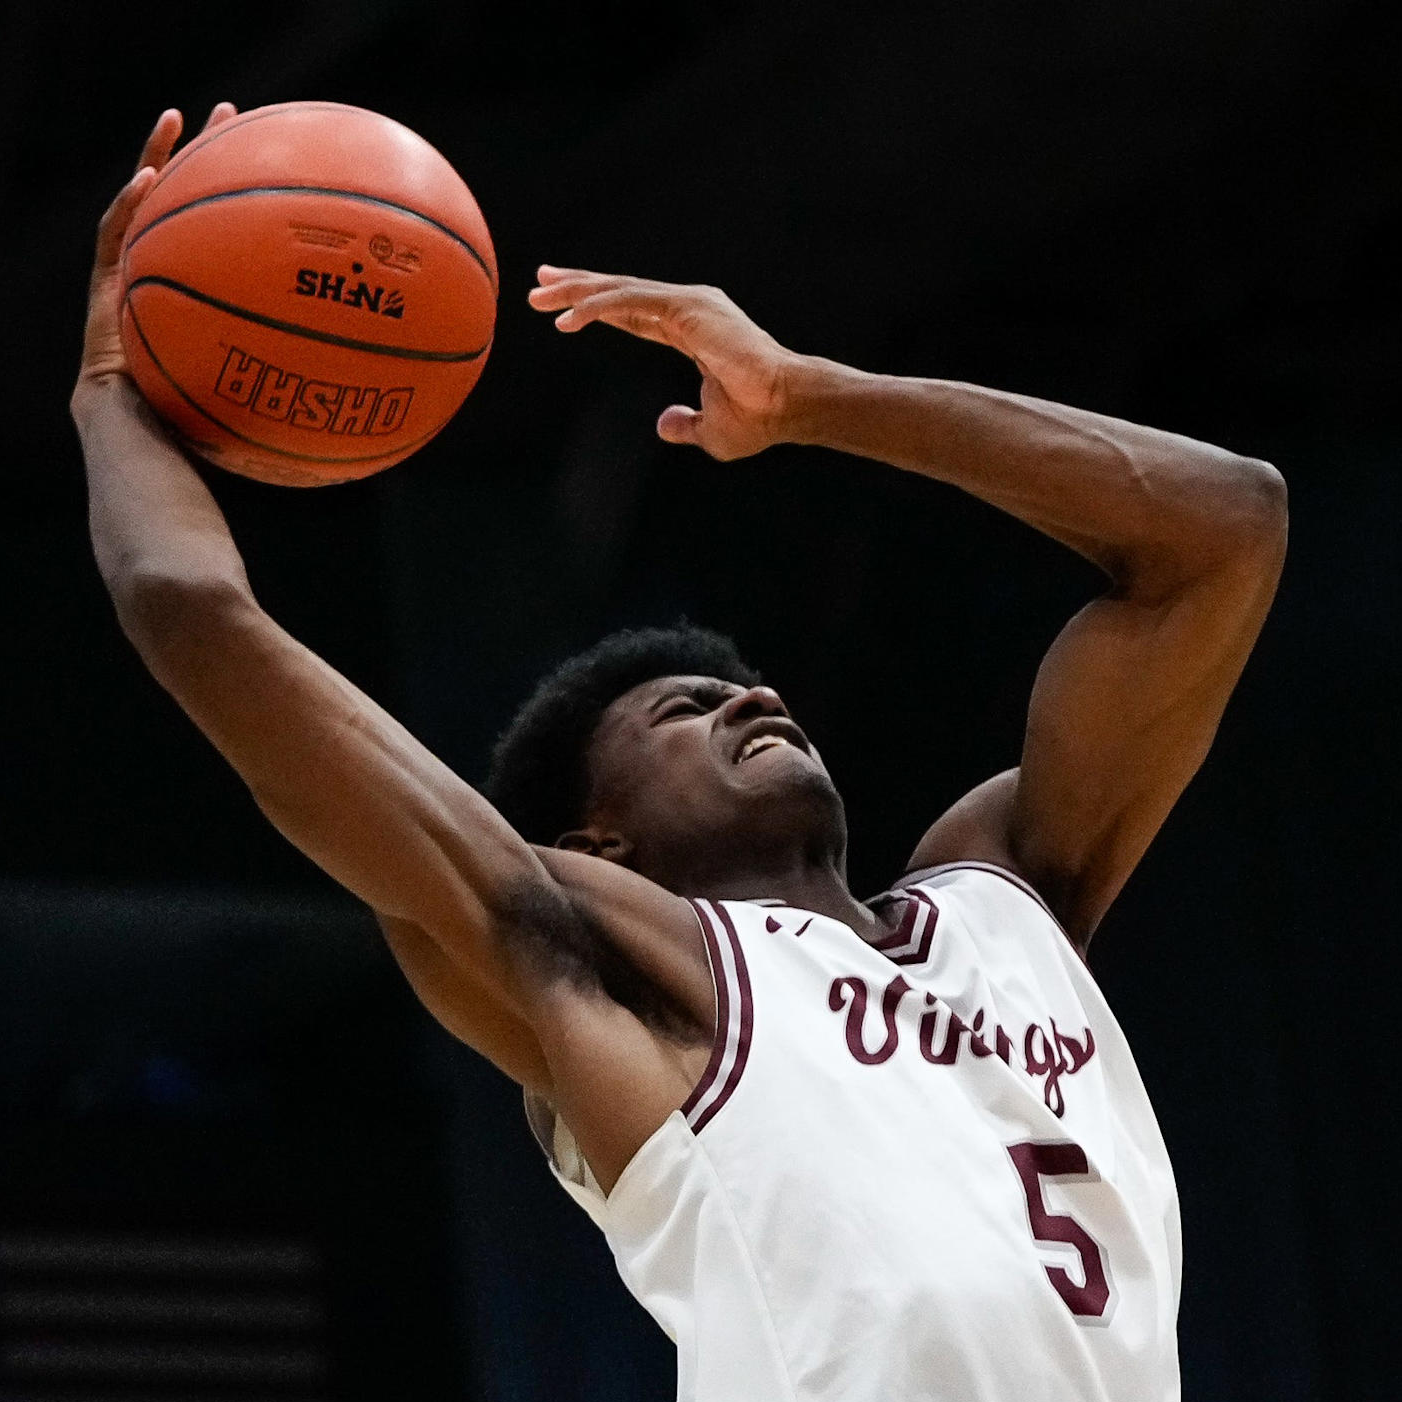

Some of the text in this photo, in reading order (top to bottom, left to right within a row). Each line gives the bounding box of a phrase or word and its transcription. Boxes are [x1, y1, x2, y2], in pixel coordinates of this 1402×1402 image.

[295, 268, 385, 314] NFHS
[214, 345, 416, 437] OHSAA
[1006, 1139, 1119, 1328] 5
